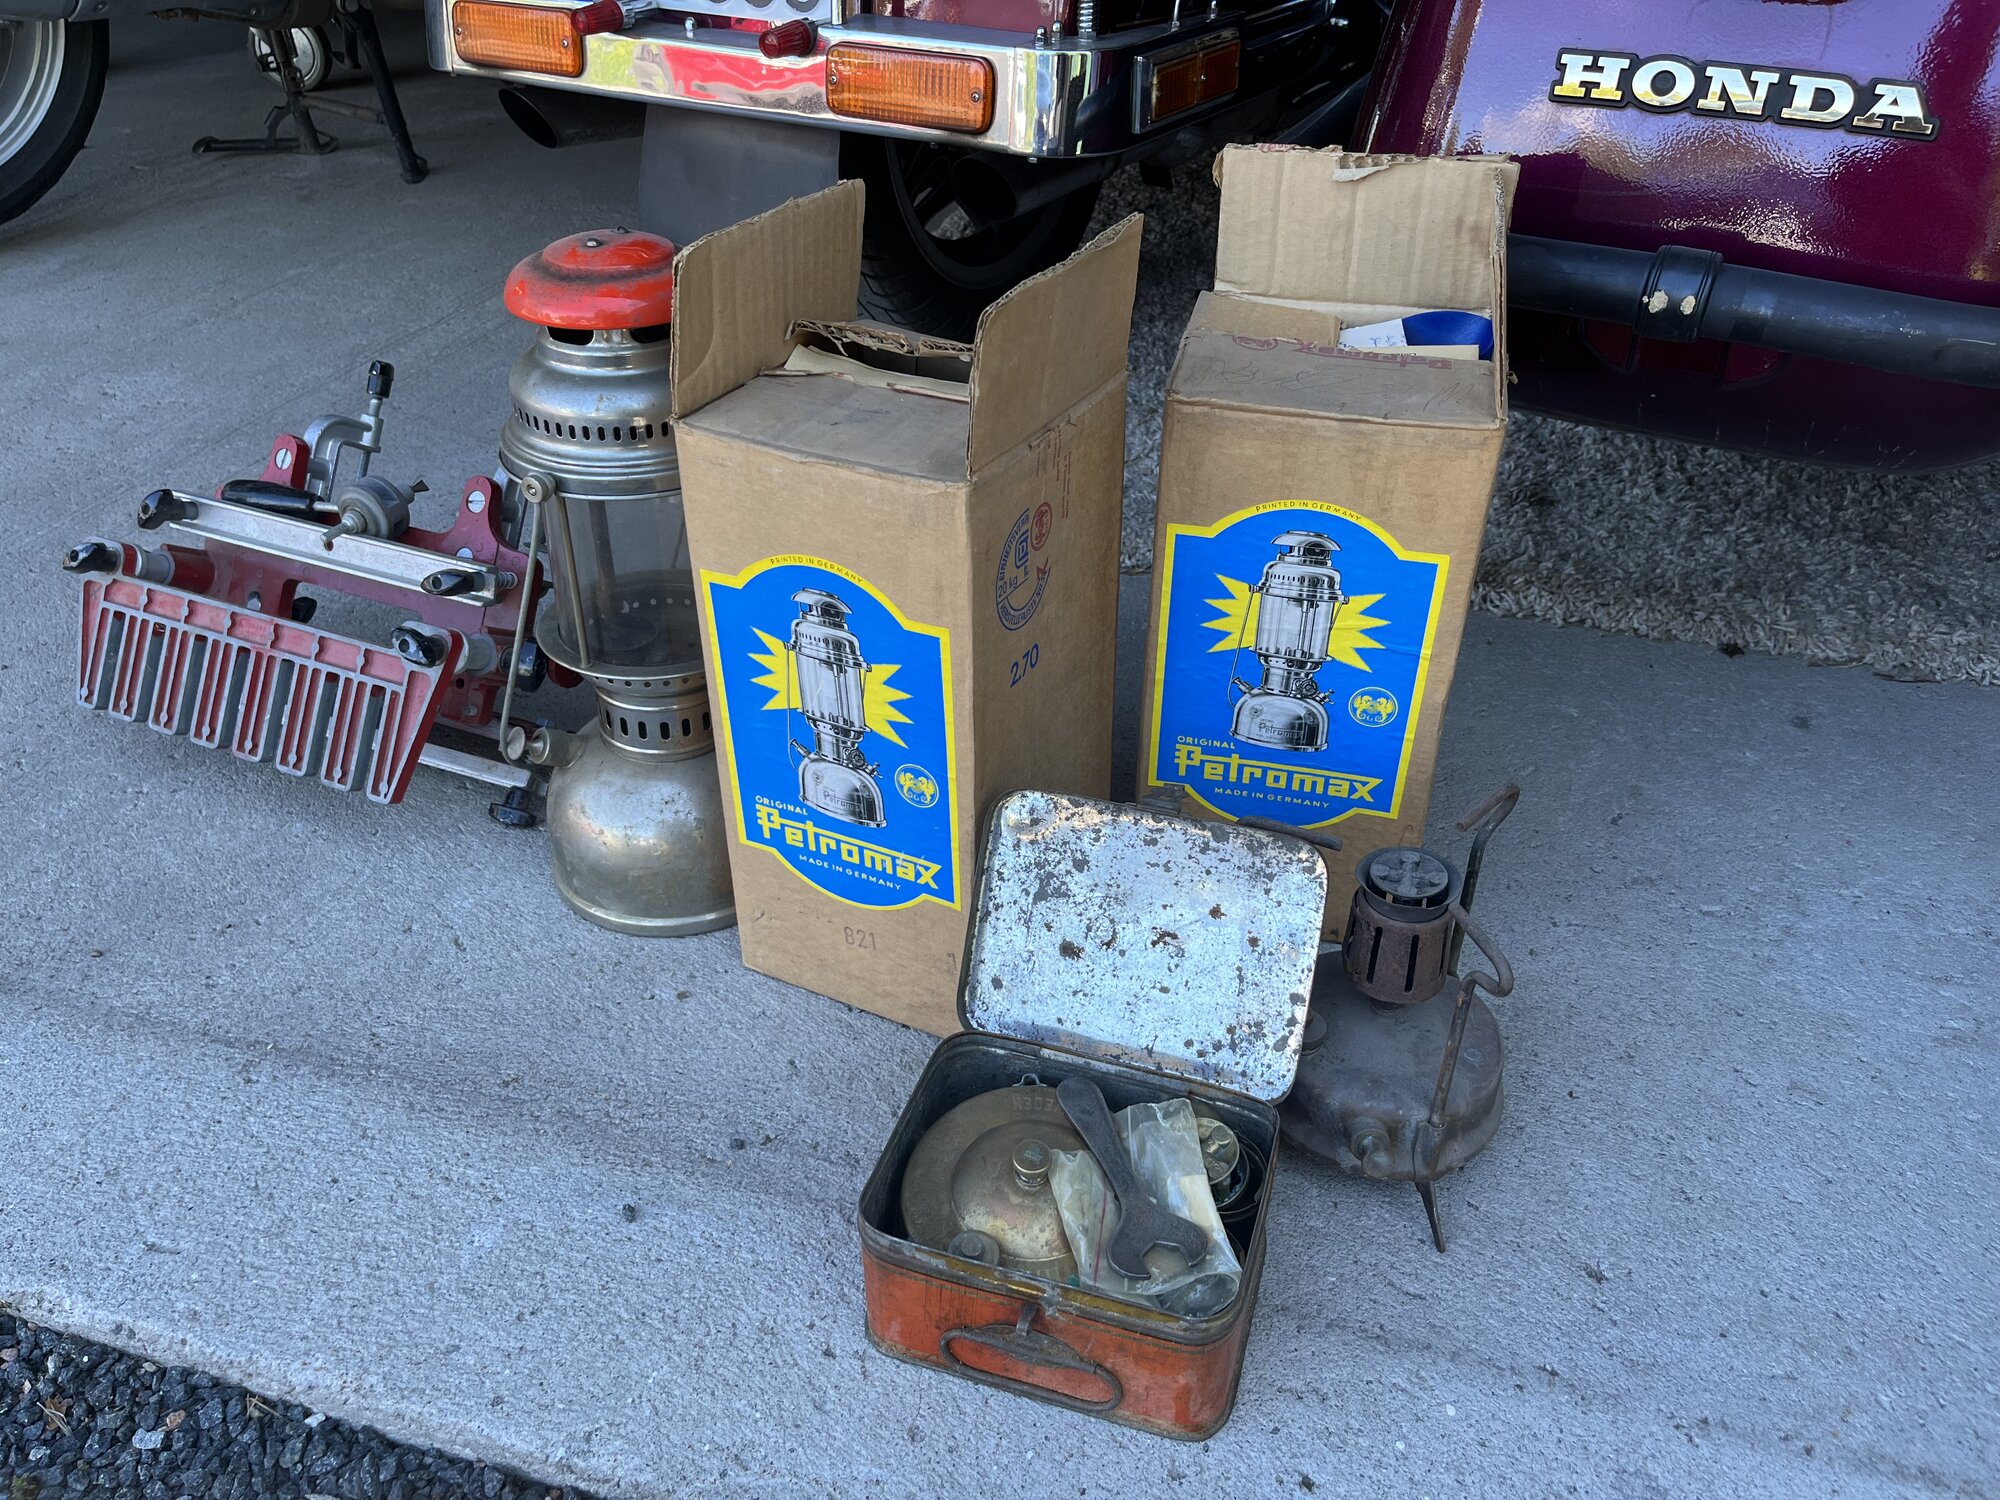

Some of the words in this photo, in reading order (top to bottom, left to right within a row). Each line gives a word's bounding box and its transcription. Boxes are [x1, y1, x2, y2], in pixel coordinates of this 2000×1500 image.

[1553, 52, 1934, 135] HONDA
[1254, 501, 1296, 512] PRINTED
[1312, 502, 1363, 522] GERMANY
[769, 555, 804, 566] PRINTED
[805, 556, 816, 565] IN
[817, 559, 864, 584] GERMANY
[998, 581, 1008, 599] 20
[1009, 576, 1018, 592] kg
[1177, 735, 1236, 750] ORIGINAL
[1174, 743, 1383, 803] Petromax
[755, 795, 809, 817] ORIGINAL
[1214, 787, 1250, 799] MADE
[1251, 791, 1264, 800] IN
[1266, 794, 1330, 809] GERMANY
[755, 804, 942, 890] Petromax
[799, 854, 830, 870] MADE
[831, 864, 844, 874] IN
[845, 866, 902, 891] GERMANY
[843, 926, 877, 951] 821
